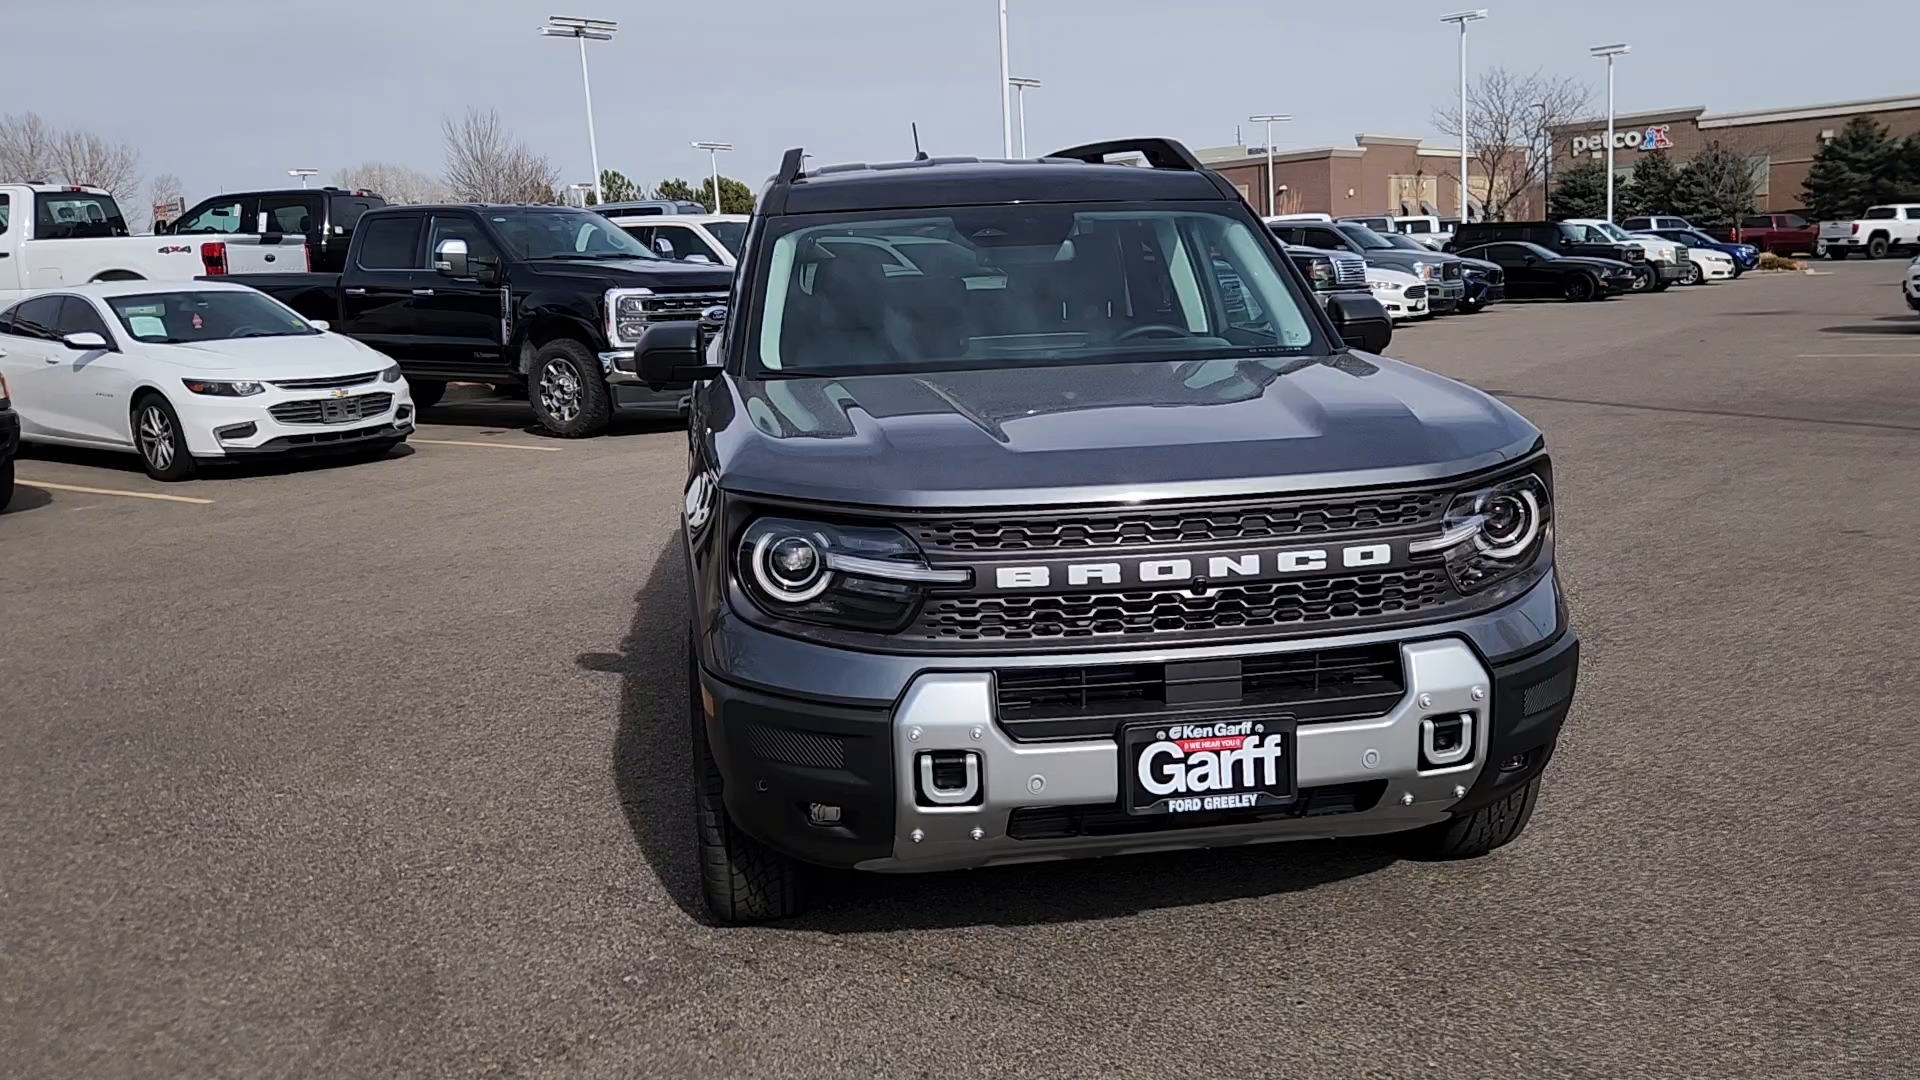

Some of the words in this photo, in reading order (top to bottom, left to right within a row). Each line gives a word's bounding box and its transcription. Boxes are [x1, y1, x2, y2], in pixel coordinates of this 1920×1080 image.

[1572, 131, 1642, 157] petco
[996, 543, 1392, 589] BRONCO
[1183, 725, 1213, 739] Ken
[1214, 721, 1253, 736] Garff
[1222, 739, 1235, 747] YOU
[1138, 734, 1281, 795] Garff
[1169, 797, 1201, 813] FORD
[1204, 794, 1258, 810] GREELEY
